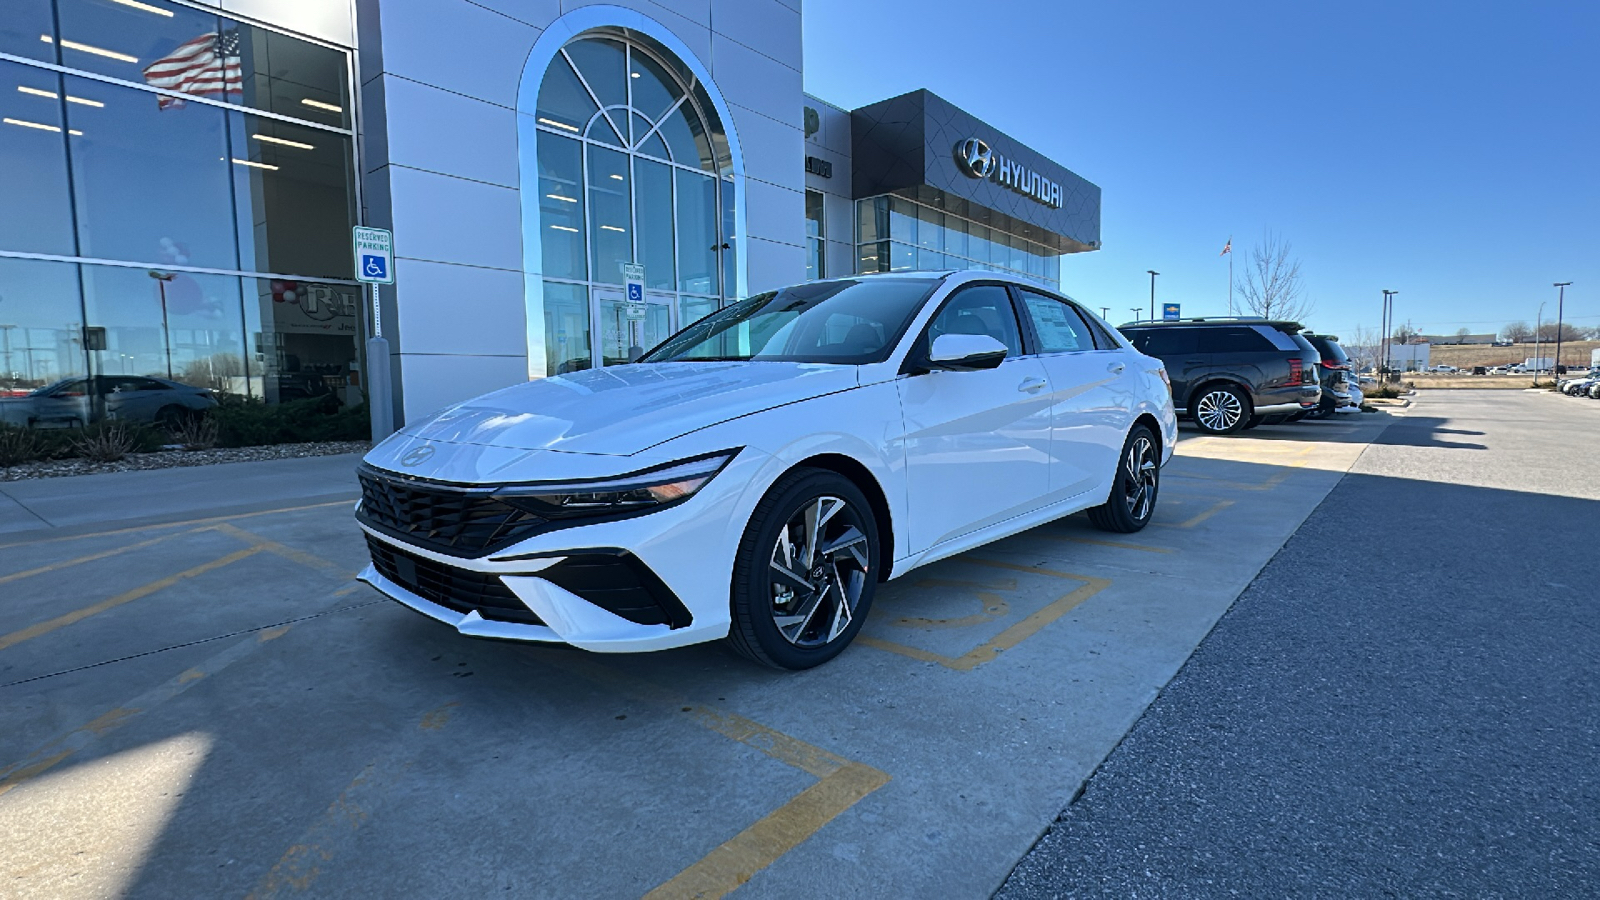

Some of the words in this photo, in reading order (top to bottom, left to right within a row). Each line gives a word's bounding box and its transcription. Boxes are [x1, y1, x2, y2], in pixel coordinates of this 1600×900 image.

[999, 154, 1063, 209] HYUNDAI
[357, 231, 389, 243] RESERVED
[357, 241, 389, 252] PARKING
